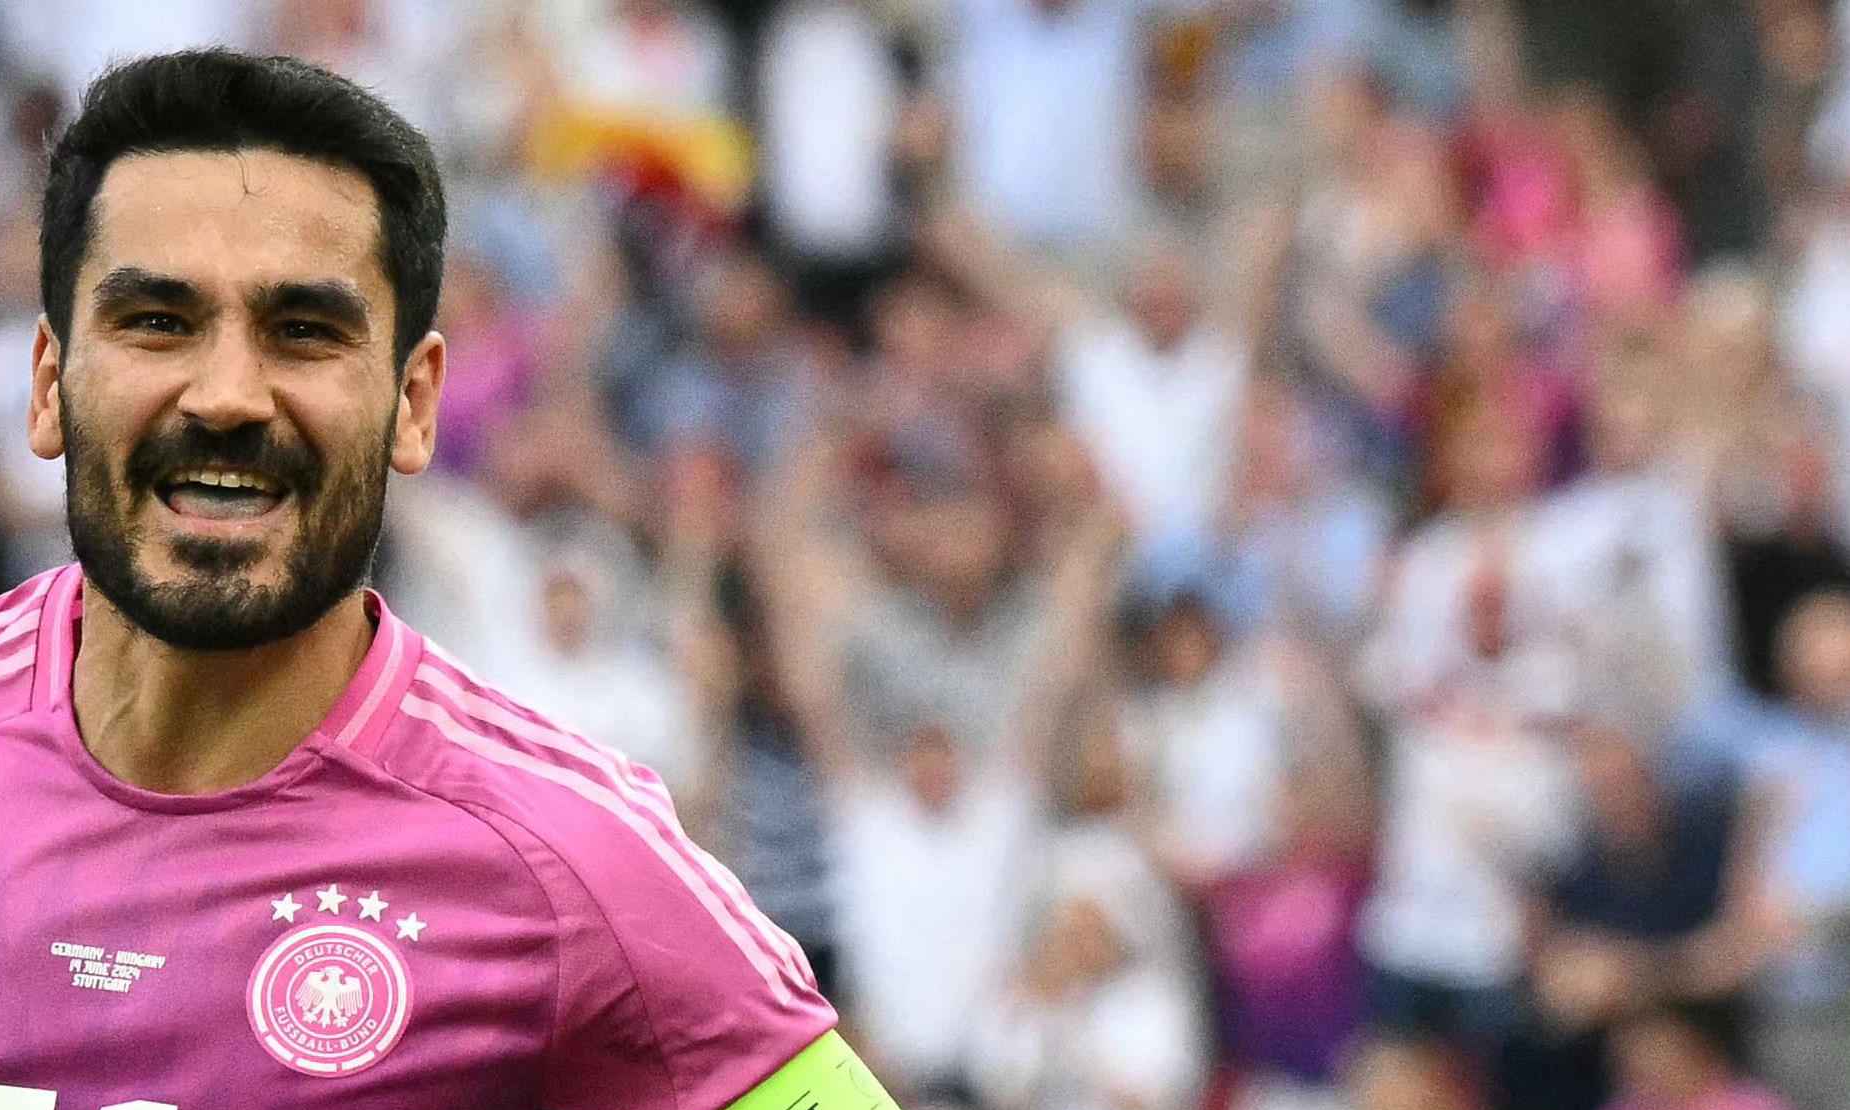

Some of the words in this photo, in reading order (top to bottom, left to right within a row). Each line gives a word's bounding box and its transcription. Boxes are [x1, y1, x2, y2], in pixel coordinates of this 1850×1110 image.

[83, 960, 111, 975] JUNE
[294, 944, 379, 975] DEUTSCHER
[72, 973, 132, 993] STUTTGART
[275, 1006, 378, 1051] FUSSBALL-BUND
